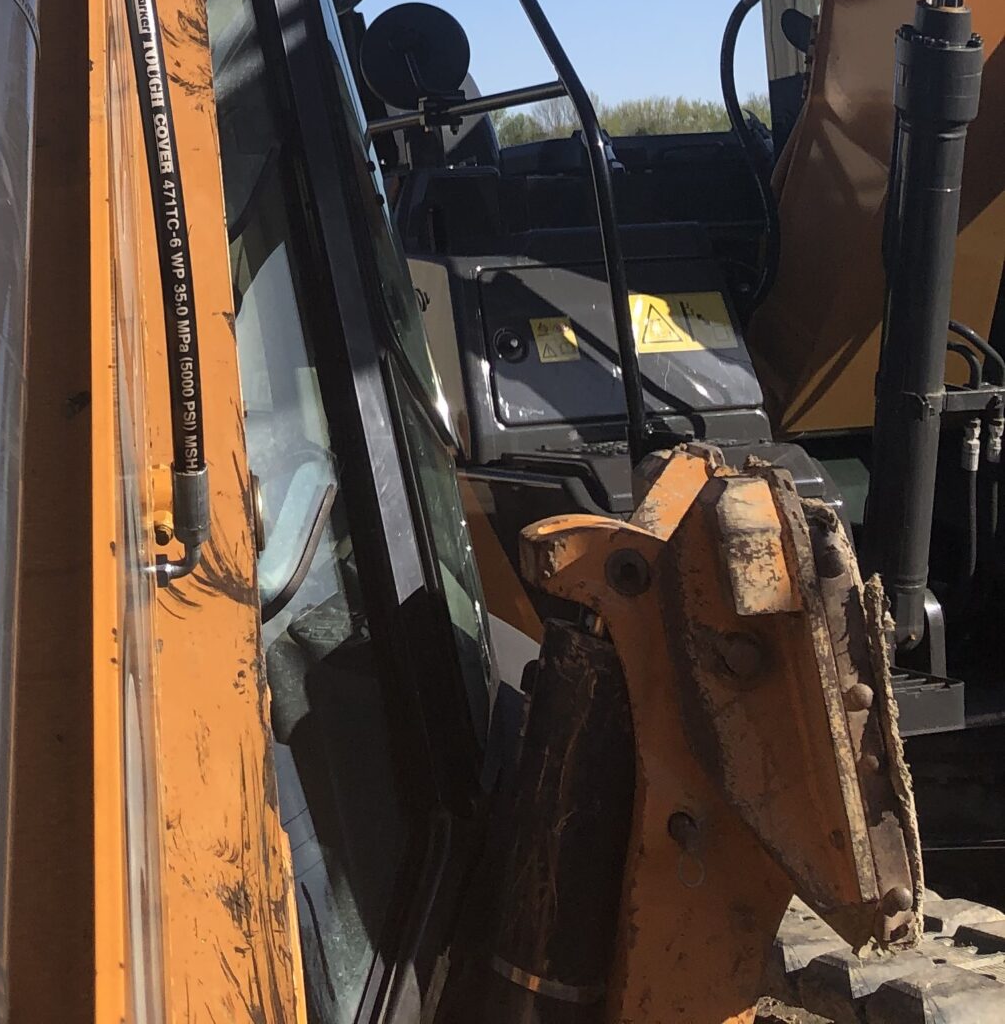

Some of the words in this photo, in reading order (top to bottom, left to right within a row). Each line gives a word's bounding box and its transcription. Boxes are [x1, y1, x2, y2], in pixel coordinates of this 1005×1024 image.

[143, 41, 165, 107] TOUGH
[152, 113, 175, 175] COVER
[162, 179, 182, 248] 471TC-6
[169, 251, 186, 279] WP
[177, 320, 192, 353] MPa
[179, 356, 195, 397] (5000
[182, 400, 197, 432] PSI)
